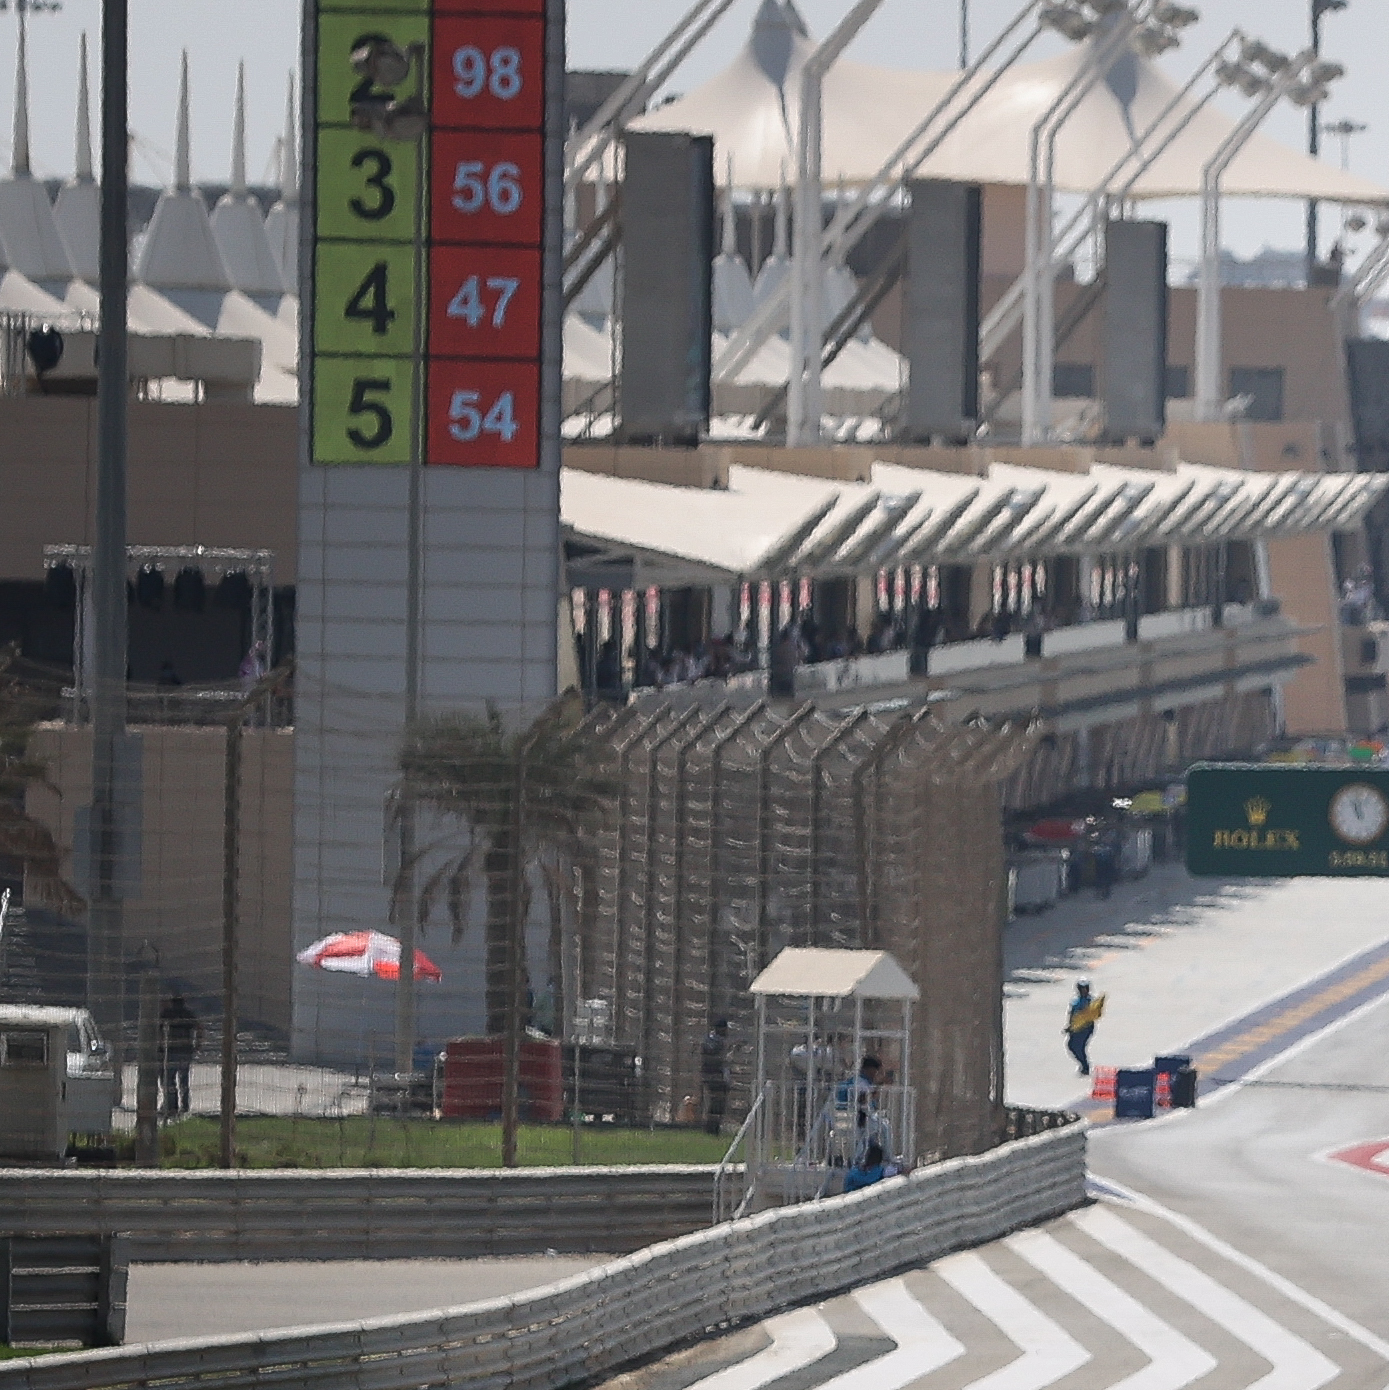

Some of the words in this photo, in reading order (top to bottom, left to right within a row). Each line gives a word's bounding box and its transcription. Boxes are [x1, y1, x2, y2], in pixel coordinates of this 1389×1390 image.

[452, 46, 522, 97] 98
[350, 149, 395, 218] 3
[452, 161, 522, 213] 56
[345, 262, 396, 333] 4
[447, 276, 520, 327] 47
[347, 378, 393, 448] 5
[448, 391, 518, 441] 54
[1213, 829, 1299, 849] ROLEX
